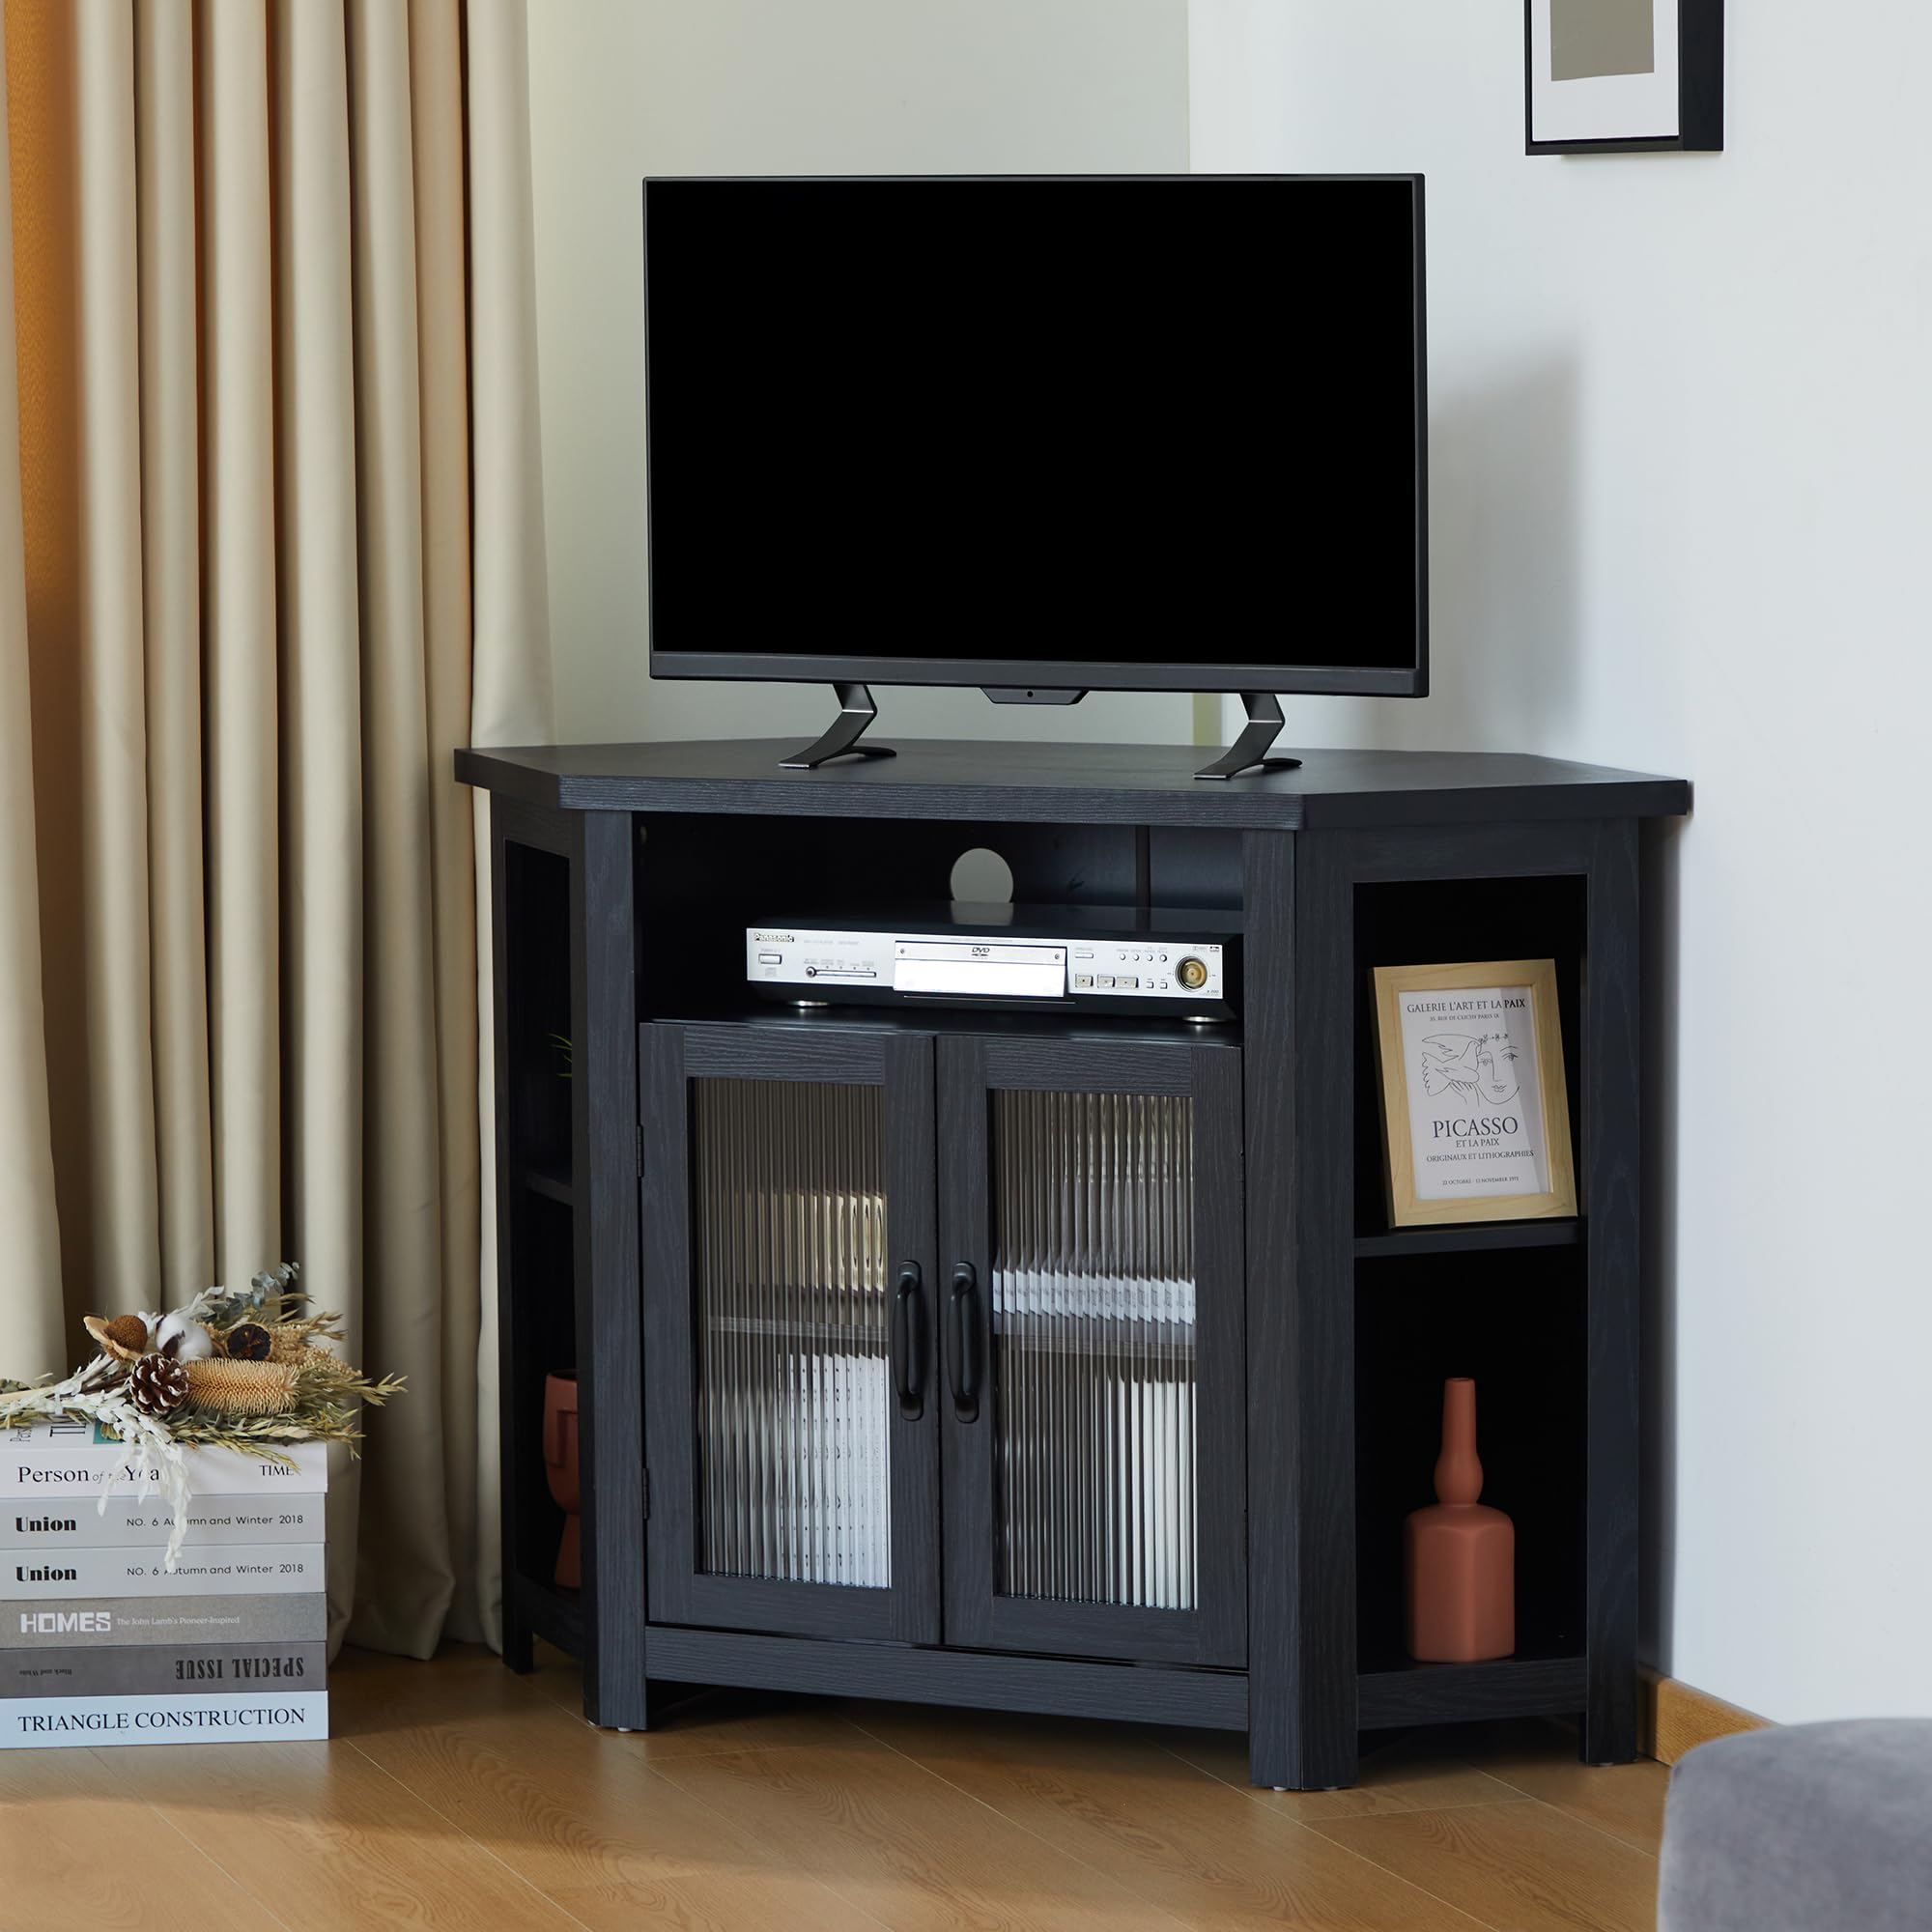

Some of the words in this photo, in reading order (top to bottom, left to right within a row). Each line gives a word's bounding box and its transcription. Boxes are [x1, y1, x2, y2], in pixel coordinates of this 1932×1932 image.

[754, 933, 795, 943] Panasonic
[1406, 1002, 1447, 1013] GALERIE
[1477, 1000, 1489, 1010] ET
[1491, 1000, 1502, 1009] LA
[1504, 998, 1526, 1009] PAIX
[1433, 1117, 1519, 1138] PICASSO
[1456, 1139, 1466, 1148] ET
[1480, 1138, 1499, 1147] PAIX
[17, 1466, 89, 1483] Person
[92, 1471, 104, 1484] of
[258, 1464, 295, 1476] TIME
[15, 1516, 77, 1532] Union
[127, 1518, 147, 1527] NO.
[152, 1518, 159, 1527] 6
[163, 1516, 207, 1526] Aumn
[209, 1515, 231, 1525] and
[236, 1515, 273, 1525] Winter
[279, 1515, 304, 1524] 2018
[15, 1565, 77, 1582] Union
[127, 1567, 147, 1576] NO.
[152, 1567, 159, 1576] 6
[209, 1564, 231, 1574] and
[236, 1564, 273, 1574] Winter
[279, 1563, 304, 1574] 2018
[20, 1612, 111, 1634] HOMES
[175, 1659, 223, 1679] ISSUE
[232, 1658, 304, 1677] SPECIAL
[17, 1713, 129, 1732] TRIANGLE
[134, 1708, 305, 1729] CONSTRUCTION
